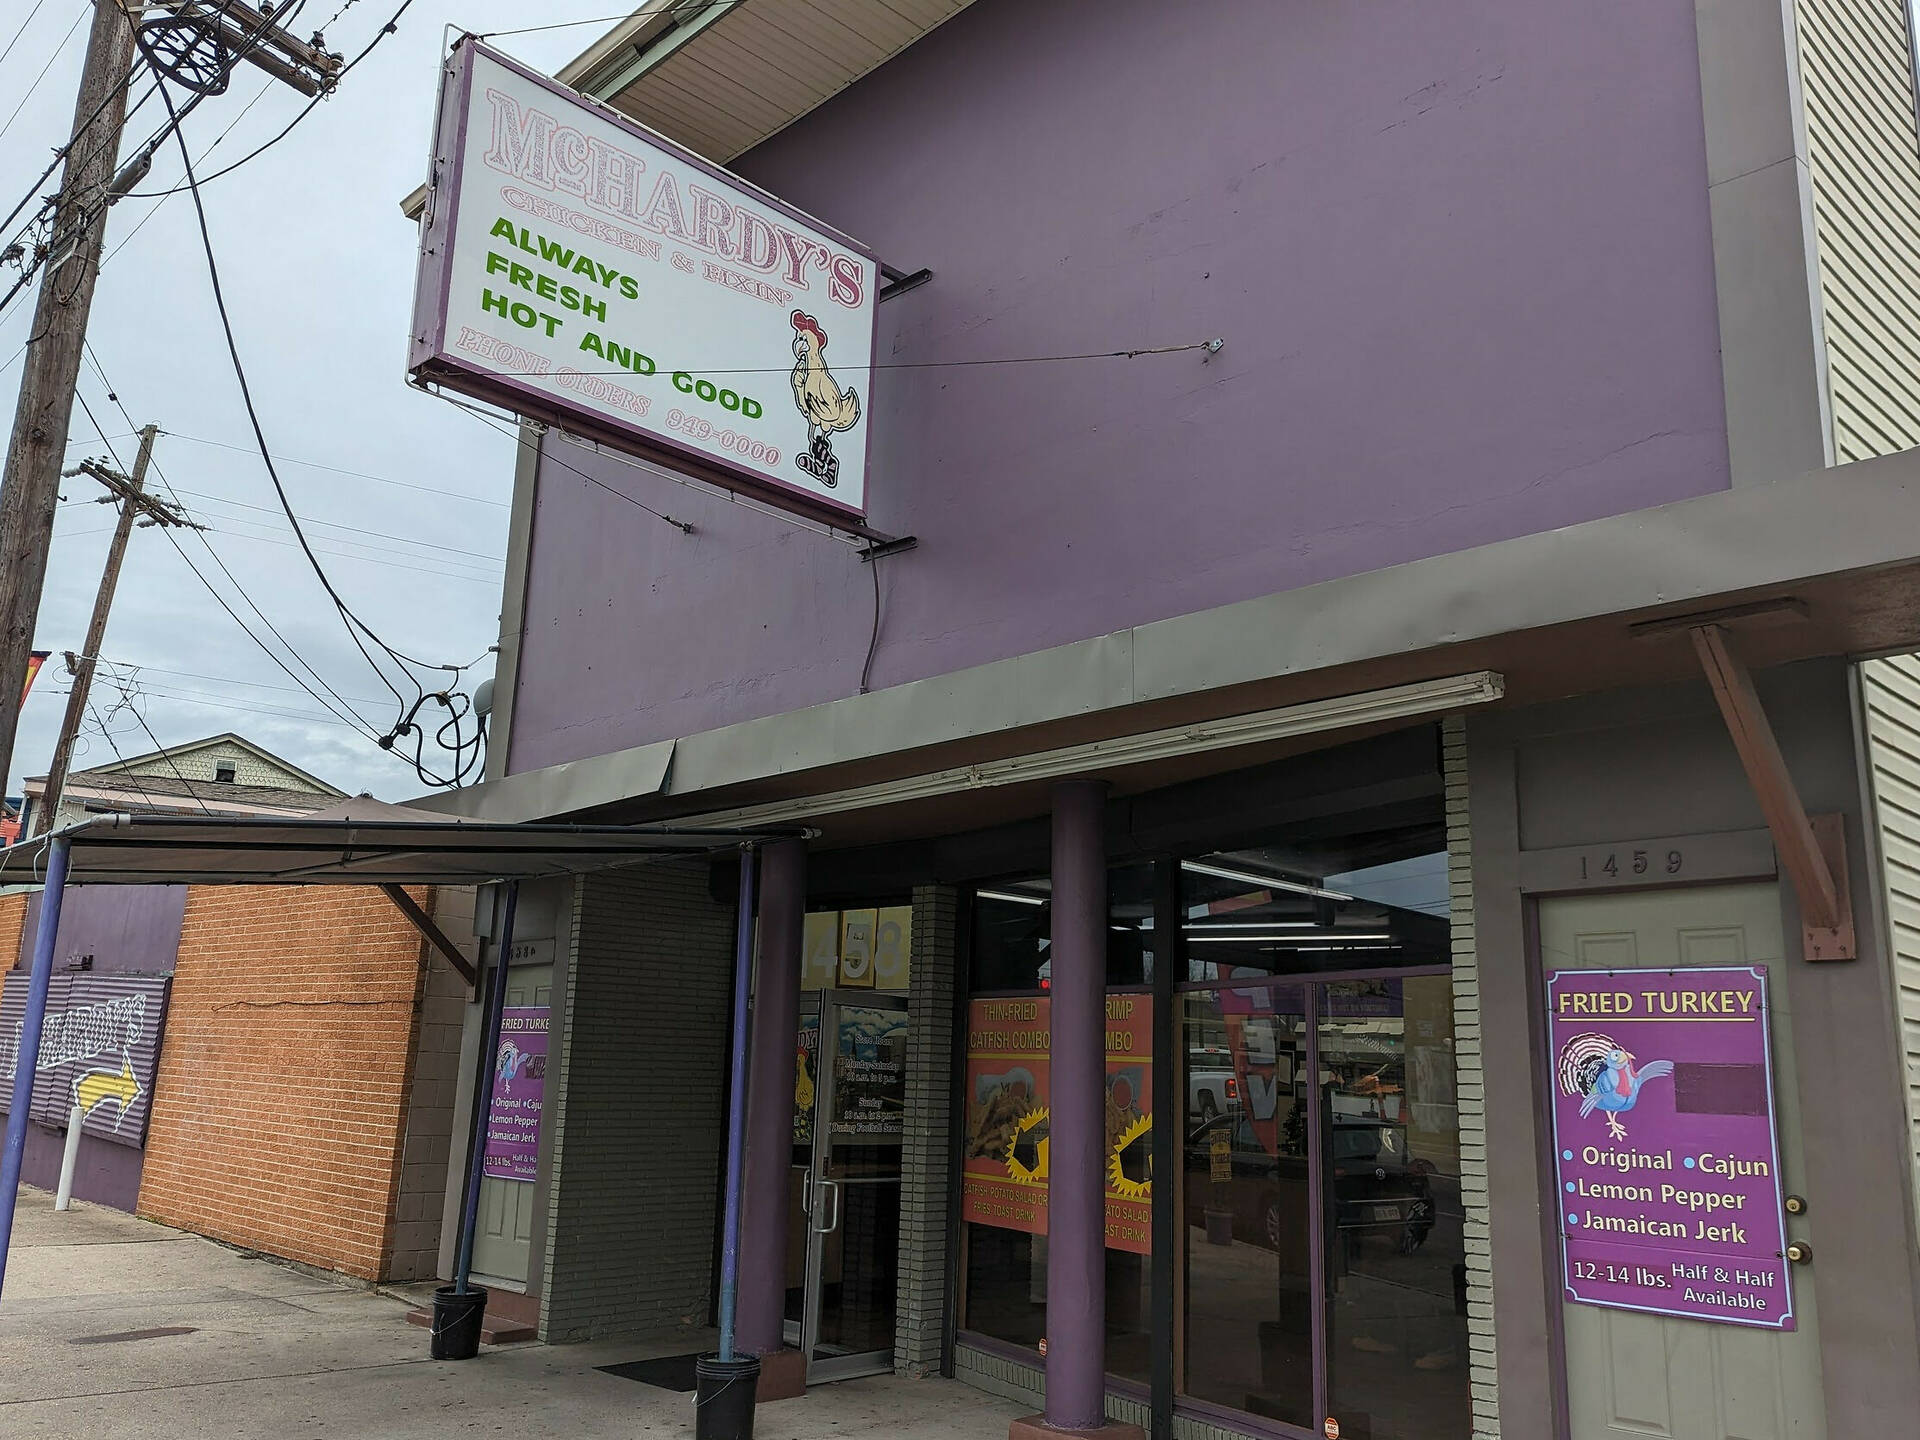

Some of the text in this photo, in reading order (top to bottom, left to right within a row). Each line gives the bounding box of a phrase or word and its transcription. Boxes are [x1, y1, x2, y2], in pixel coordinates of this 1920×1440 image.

[500, 186, 793, 307] CHICKEN & FIXIN'
[489, 217, 639, 300] ALWAYS
[486, 251, 607, 323] FRESH
[481, 288, 763, 419] HOT AND GOOD
[456, 327, 781, 467] PHONE ORDERS 949-0000
[1579, 850, 1683, 880] 1459
[983, 1002, 1038, 1021] THIN-FRIED
[1106, 1001, 1134, 1020] RIMP
[1558, 990, 1755, 1015] FRIED TURKEY
[501, 1018, 550, 1029] FRIED TURKE
[970, 1031, 1050, 1050] CATFISH COMBO
[1106, 1032, 1133, 1050] MBO
[495, 1097, 543, 1112] Original Caju
[492, 1113, 538, 1128] Lemon Pepper
[491, 1130, 536, 1142] Jamaican Jerk
[486, 1156, 501, 1166] 12-14
[512, 1154, 522, 1162] Half
[1582, 1146, 1769, 1180] Original Cajun
[1015, 1190, 1037, 1205] SALAD
[1577, 1177, 1746, 1212] Lemon Pepper
[1015, 1208, 1036, 1222] DRINK
[1105, 1204, 1149, 1223] ATO SALAD
[1105, 1225, 1146, 1242] AST DRINK
[1582, 1210, 1747, 1244] Jamaican Jerk
[1574, 1261, 1672, 1288] 12-14 lbs.
[1671, 1262, 1775, 1288] Half & Half
[1683, 1287, 1767, 1310] Available
